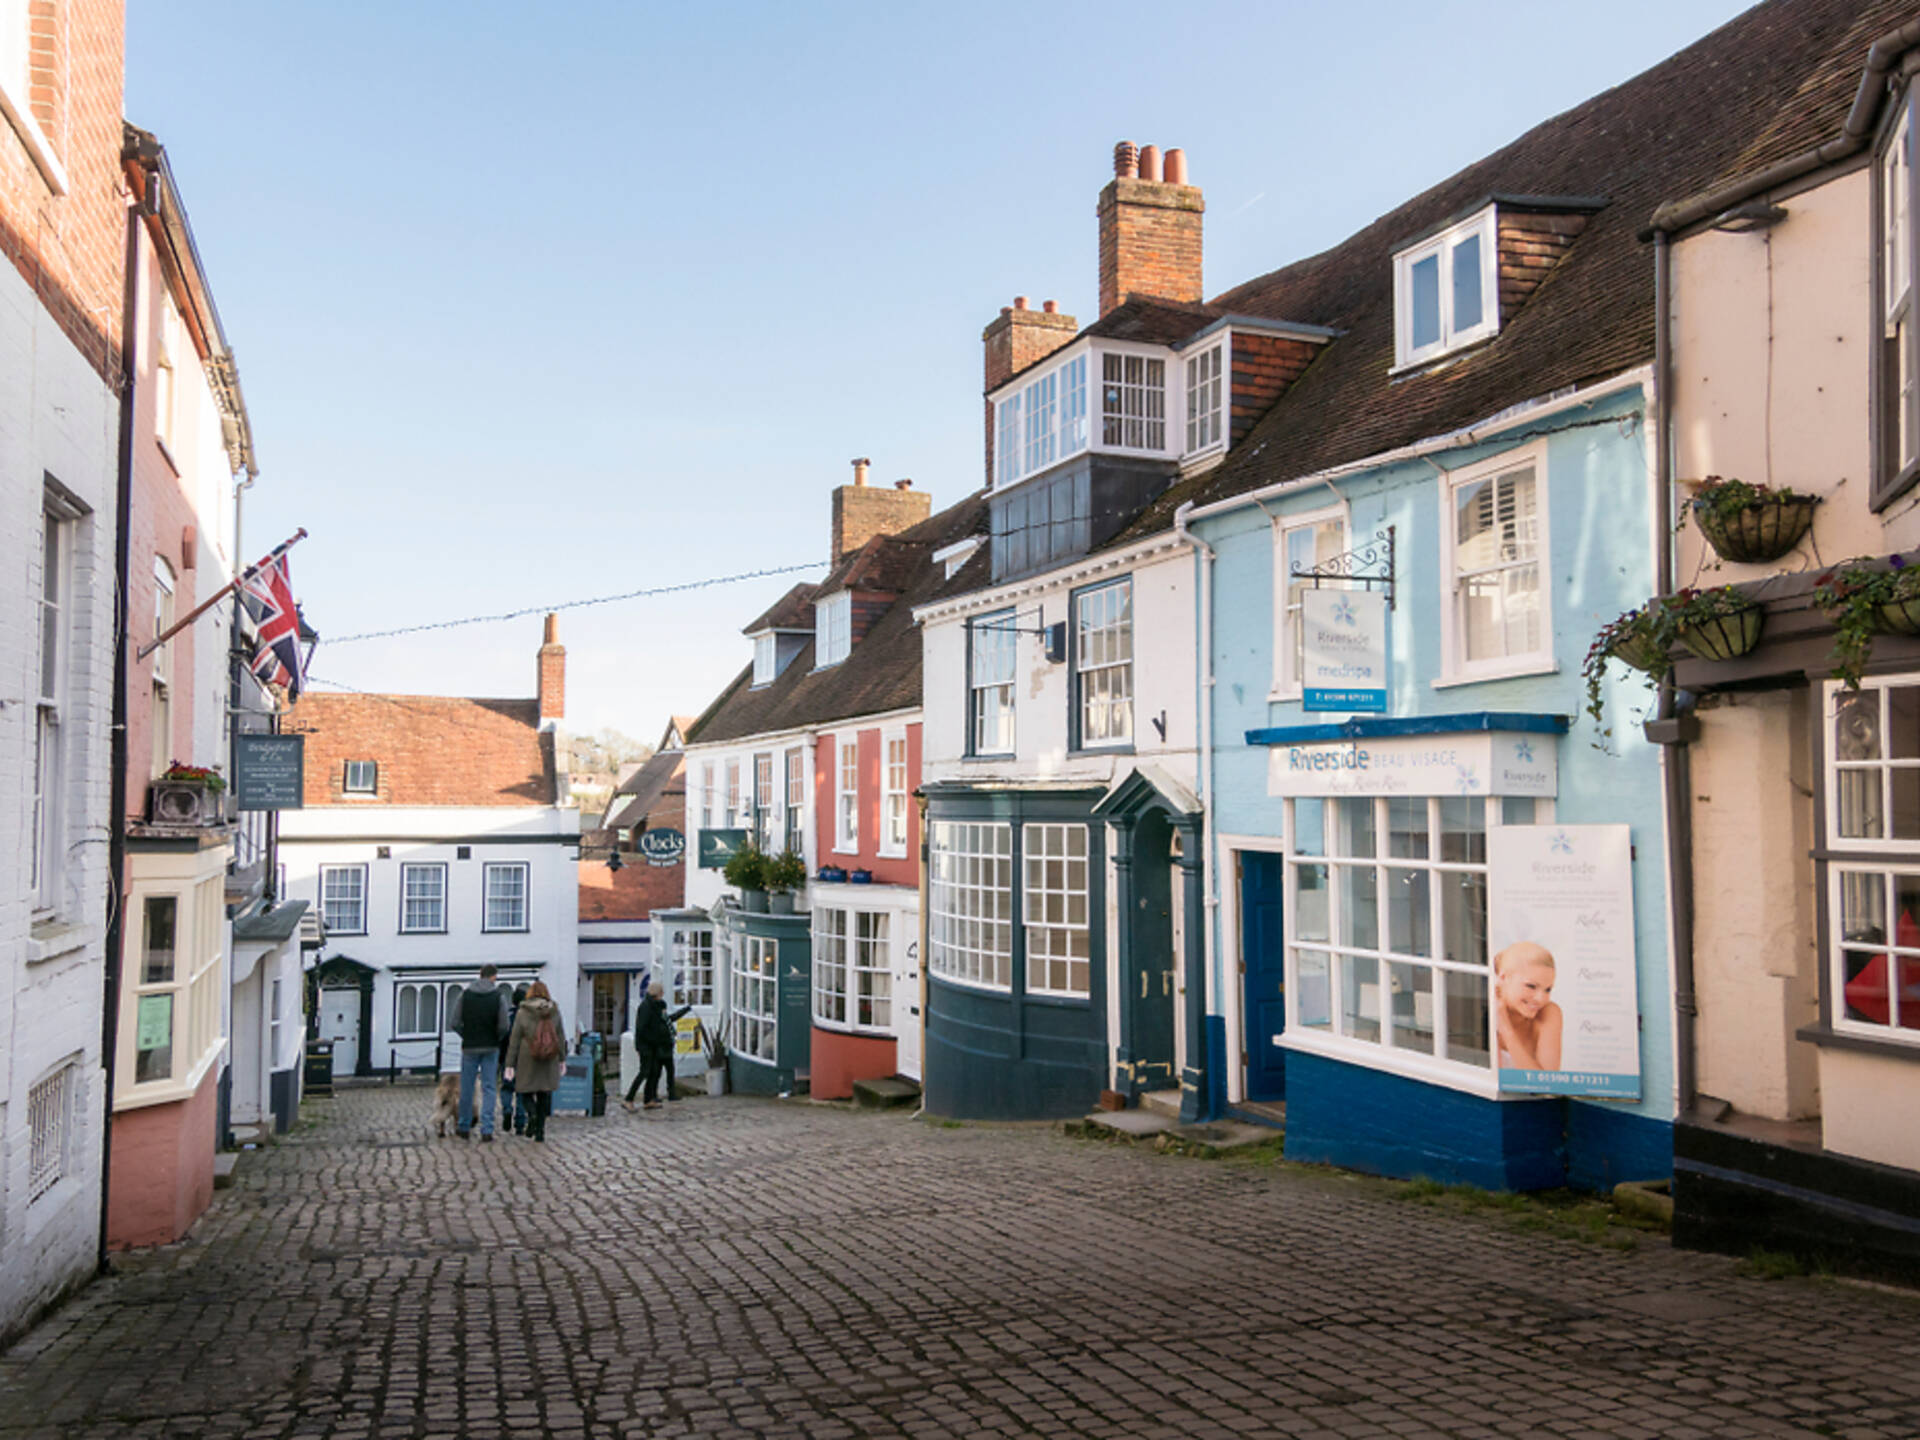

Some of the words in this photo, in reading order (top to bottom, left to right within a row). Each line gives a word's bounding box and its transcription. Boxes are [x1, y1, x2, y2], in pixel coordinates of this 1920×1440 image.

[1288, 742, 1370, 770] Riverside
[1374, 753, 1405, 768] BEAU
[1410, 750, 1457, 767] VISAGE
[1531, 861, 1597, 874] Riverside
